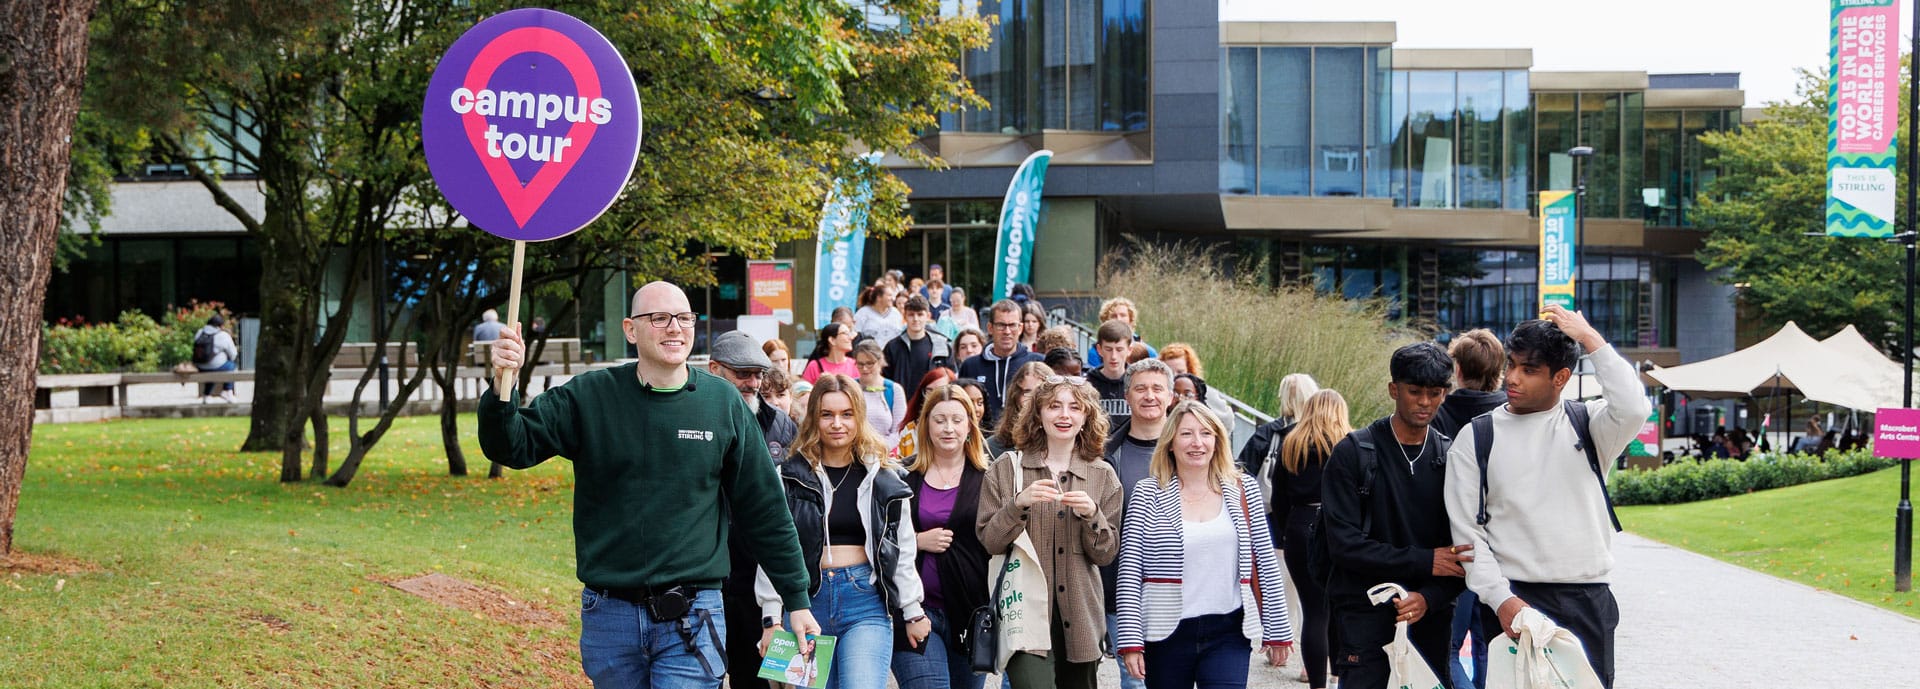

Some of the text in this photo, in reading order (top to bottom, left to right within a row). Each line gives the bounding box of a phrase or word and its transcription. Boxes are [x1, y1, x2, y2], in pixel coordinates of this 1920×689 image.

[1842, 15, 1858, 52] THE
[1858, 15, 1875, 58] FOR
[1842, 55, 1857, 77] IN
[1872, 14, 1887, 141] CAREERS SERVICES
[1842, 80, 1857, 100] 15
[1856, 63, 1874, 141] WORLD
[450, 87, 613, 129] campus
[1841, 103, 1857, 141] TOP
[484, 124, 573, 163] tour
[1838, 182, 1886, 192] STIRLING
[1005, 191, 1027, 297] welcome
[1546, 235, 1558, 261] TOP
[829, 241, 848, 300] open
[1546, 262, 1558, 281] UK
[1880, 424, 1917, 432] Macrobert
[1880, 432, 1920, 441] Arts Centre
[1006, 559, 1020, 572] es
[1000, 590, 1023, 610] ople
[771, 645, 786, 654] day
[774, 638, 795, 648] open
